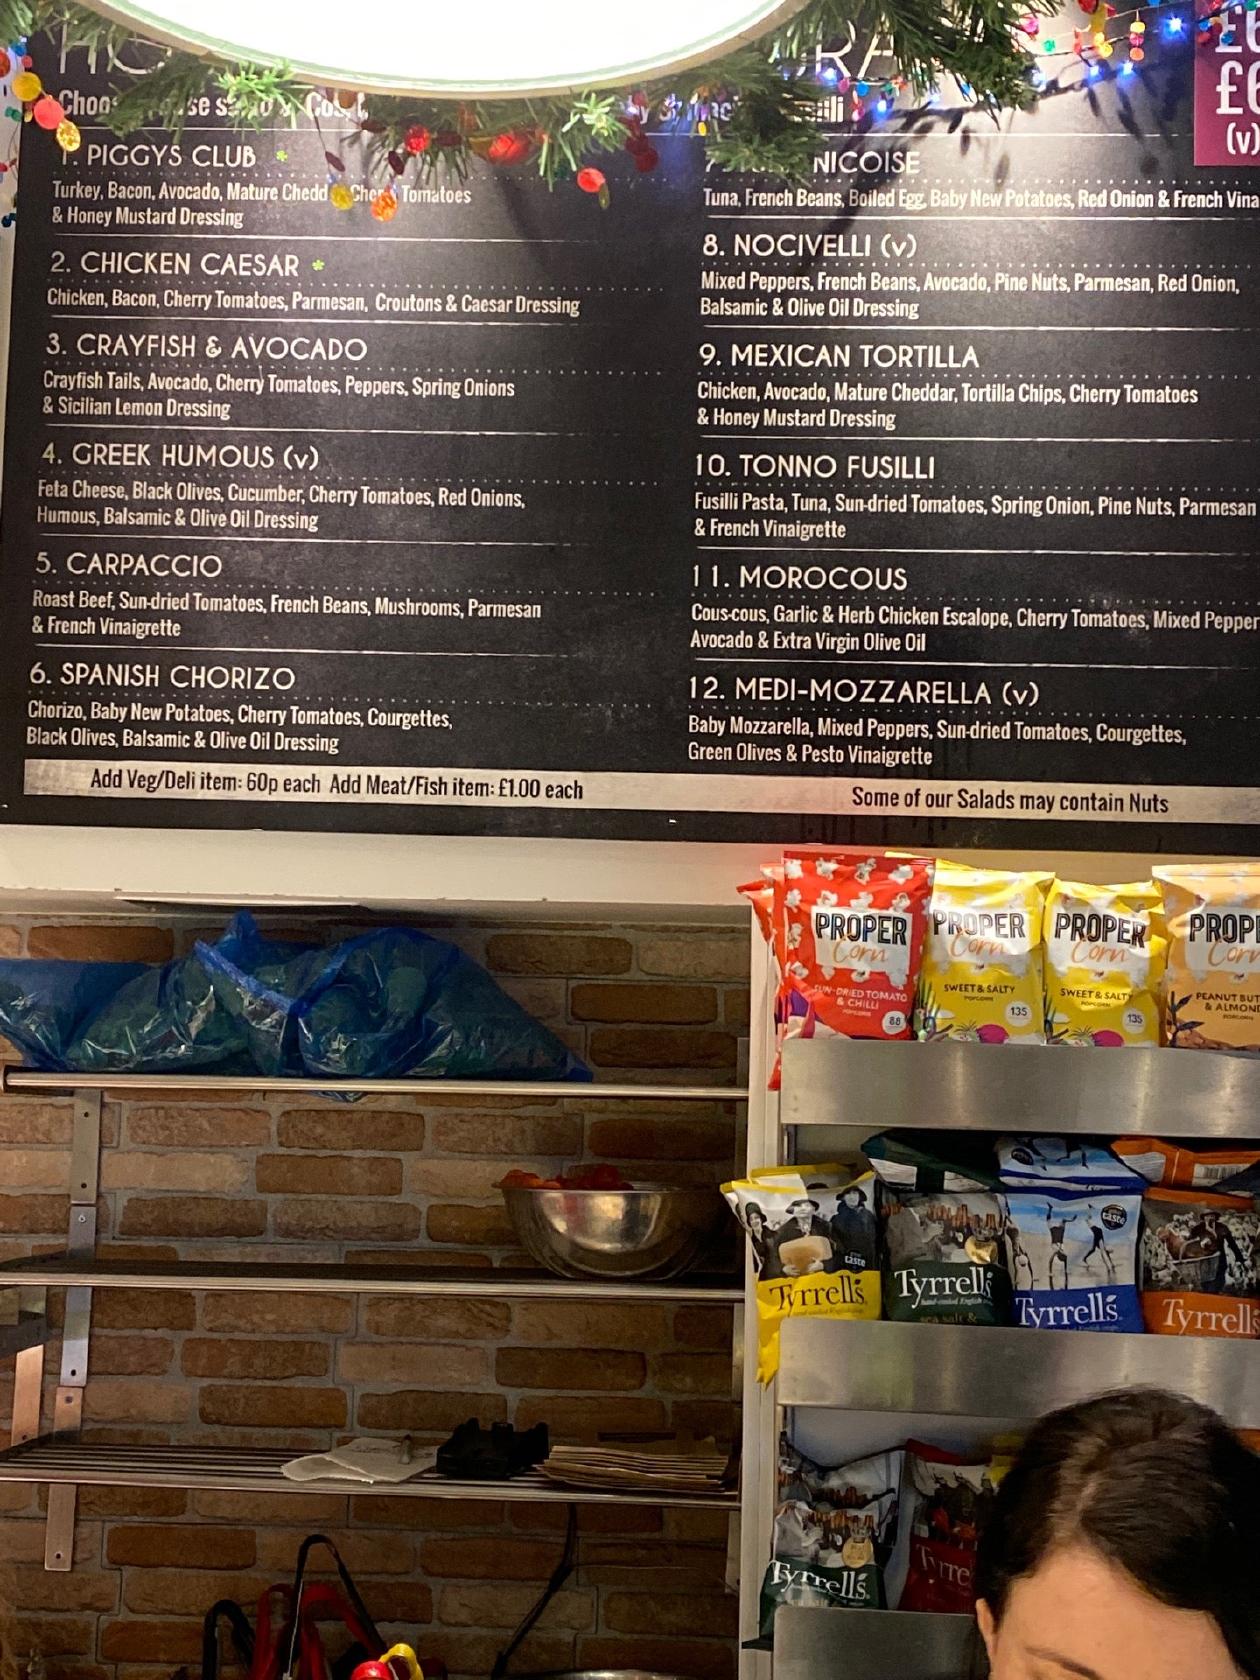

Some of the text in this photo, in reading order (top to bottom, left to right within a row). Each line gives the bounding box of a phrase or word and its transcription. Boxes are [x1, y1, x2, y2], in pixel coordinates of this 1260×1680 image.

[1226, 121, 1260, 156] (v)
[87, 144, 183, 167] PIGGYS
[191, 144, 256, 168] CLUB
[813, 150, 921, 174] NICOISE
[702, 233, 917, 258] 8. NOCIVELLI (v)
[50, 250, 299, 277] 2. CHICKEN CAESAR
[701, 270, 1240, 295] Mixed Peppers, French Beans, Avocado, Pine Nuts, Parmesan, Red Onion,
[47, 287, 581, 318] Chicken, Bacon, Cherry Tomatoes, Parmesan, Croutons & Caesar Dressing
[45, 332, 368, 361] 3. CRAYFISH & AVOCADO
[699, 343, 980, 368] 9. MEXICAN TORTILLA
[43, 369, 515, 400] Crayfish Tails, Avocado, Cherry Tomatoes, Peppers, Spring Onions
[697, 380, 1199, 406] Chicken, Avocado, Mature Cheddar, Tortilla Chips, Cherry Tomatoes
[42, 395, 232, 421] & Sicilian Lemon Dressing
[42, 442, 319, 471] 4. GREEK HUMOUS (v)
[696, 453, 935, 480] 10. TONNO FUSILLI
[694, 517, 847, 542] & French Vinaigrette
[35, 551, 223, 578] 5. CARPACCIO
[738, 566, 909, 592] MOROCOUS
[32, 589, 542, 620] Roast Beef, Sun-dried Tomatoes, French Beans, Mushrooms, Parmesan
[691, 602, 770, 625] Cous-cous,
[773, 604, 819, 624] Garlic
[821, 604, 835, 624] &
[838, 605, 875, 624] Herb
[878, 605, 939, 626] Chicken
[942, 606, 1013, 630] Escalope,
[1016, 607, 1068, 630] Cherry
[1070, 608, 1150, 631] Tomatoes,
[1153, 610, 1201, 629] Mixed
[29, 661, 296, 690] 6. SPANISH CHORIZO
[690, 676, 1039, 707] 12. MEDI-MOZZARELLA (v)
[90, 768, 584, 800] Add Veg/Deli item: 60p each Add Meat/Fish item: £1.00 each
[852, 786, 1169, 814] Some of our Salads may contain Nuts
[815, 912, 907, 946] PROPER
[932, 909, 1026, 938] PROPER
[1054, 912, 1146, 948] PROPER
[832, 933, 888, 964] Corn
[1071, 937, 1126, 964] Corn
[866, 989, 908, 1003] TOMATO
[943, 983, 1016, 994] SWEET & SALTY
[1060, 987, 1134, 1002] SWEET & SALTY
[1195, 991, 1238, 1003] PEANUT
[847, 998, 880, 1010] CHILLI
[1009, 1006, 1028, 1017] 135
[1127, 1013, 1143, 1024] 135
